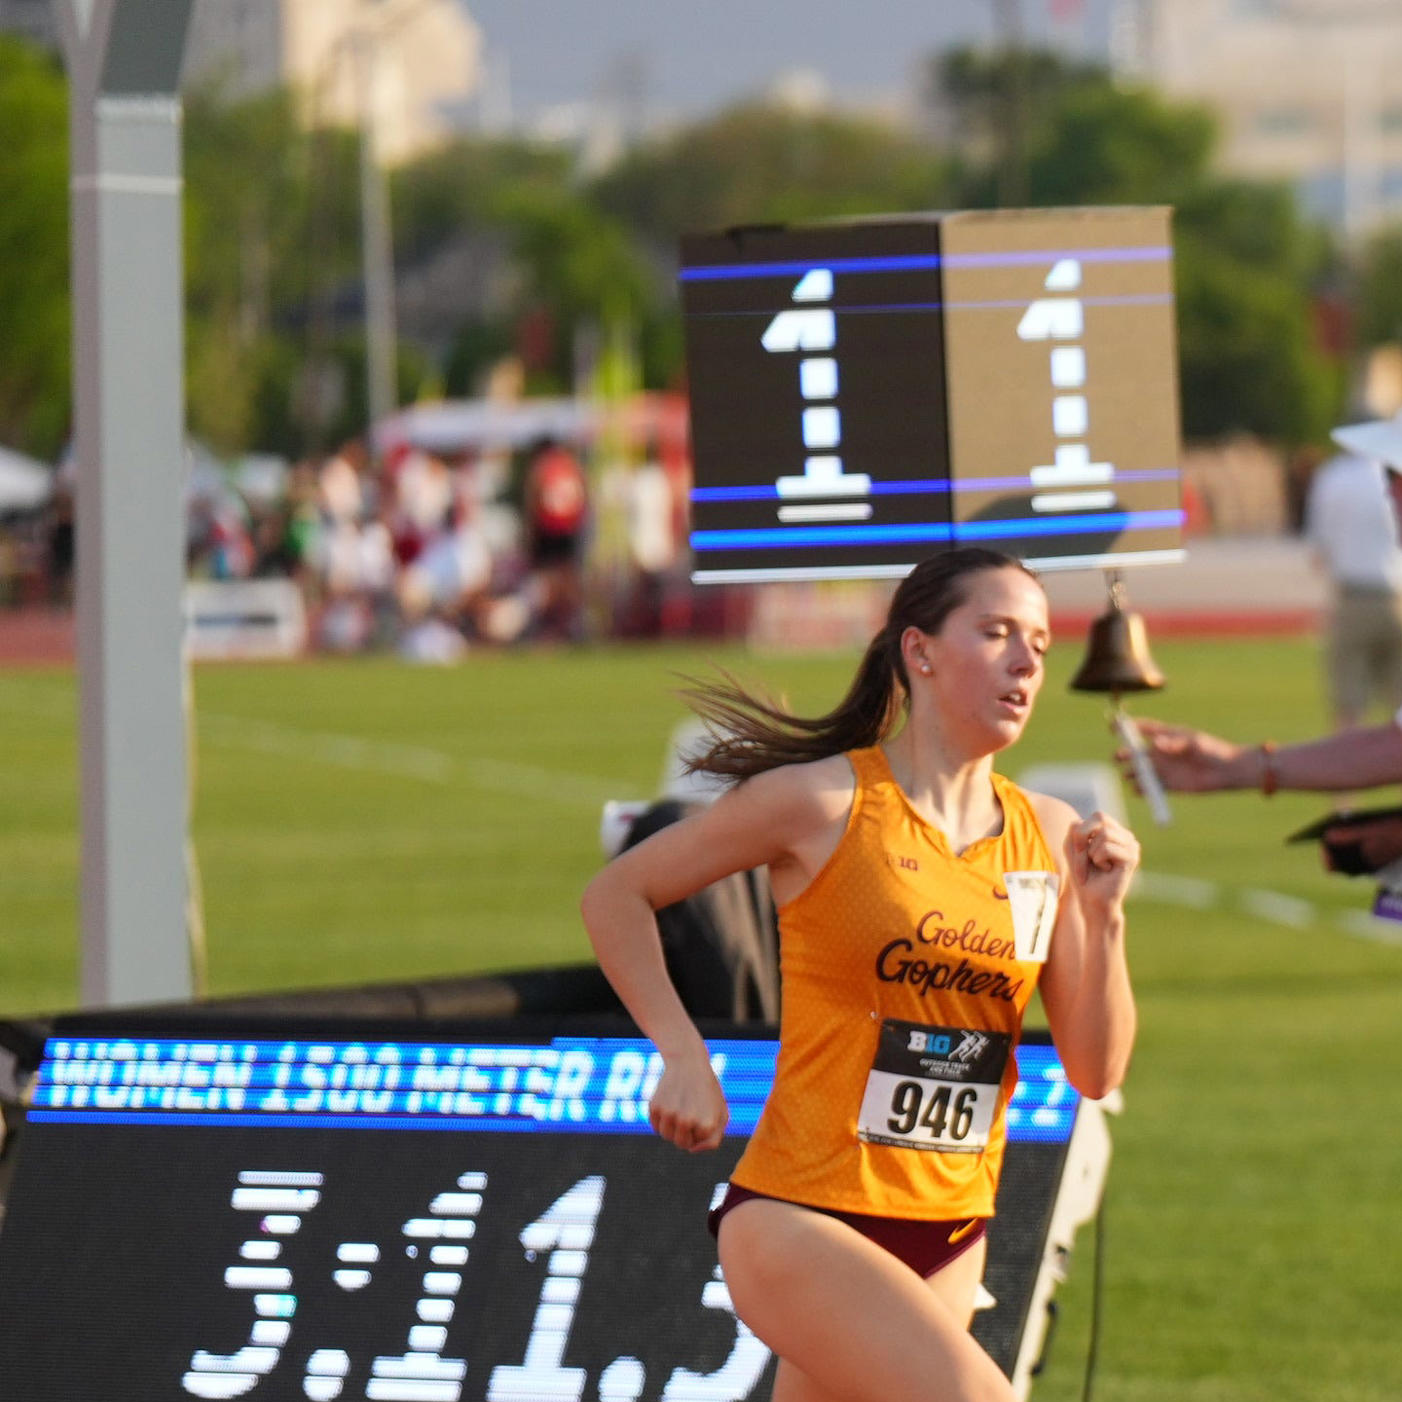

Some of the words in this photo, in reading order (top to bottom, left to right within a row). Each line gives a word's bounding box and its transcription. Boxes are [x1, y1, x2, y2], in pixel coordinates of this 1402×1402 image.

[761, 267, 872, 523] 1
[1016, 258, 1116, 512] 1
[876, 938, 1024, 1002] Gophers
[916, 910, 1015, 960] Golden
[50, 1040, 258, 1110] WOMEN
[260, 1042, 402, 1114] 1500
[406, 1045, 597, 1122] METER
[887, 1079, 977, 1141] 946
